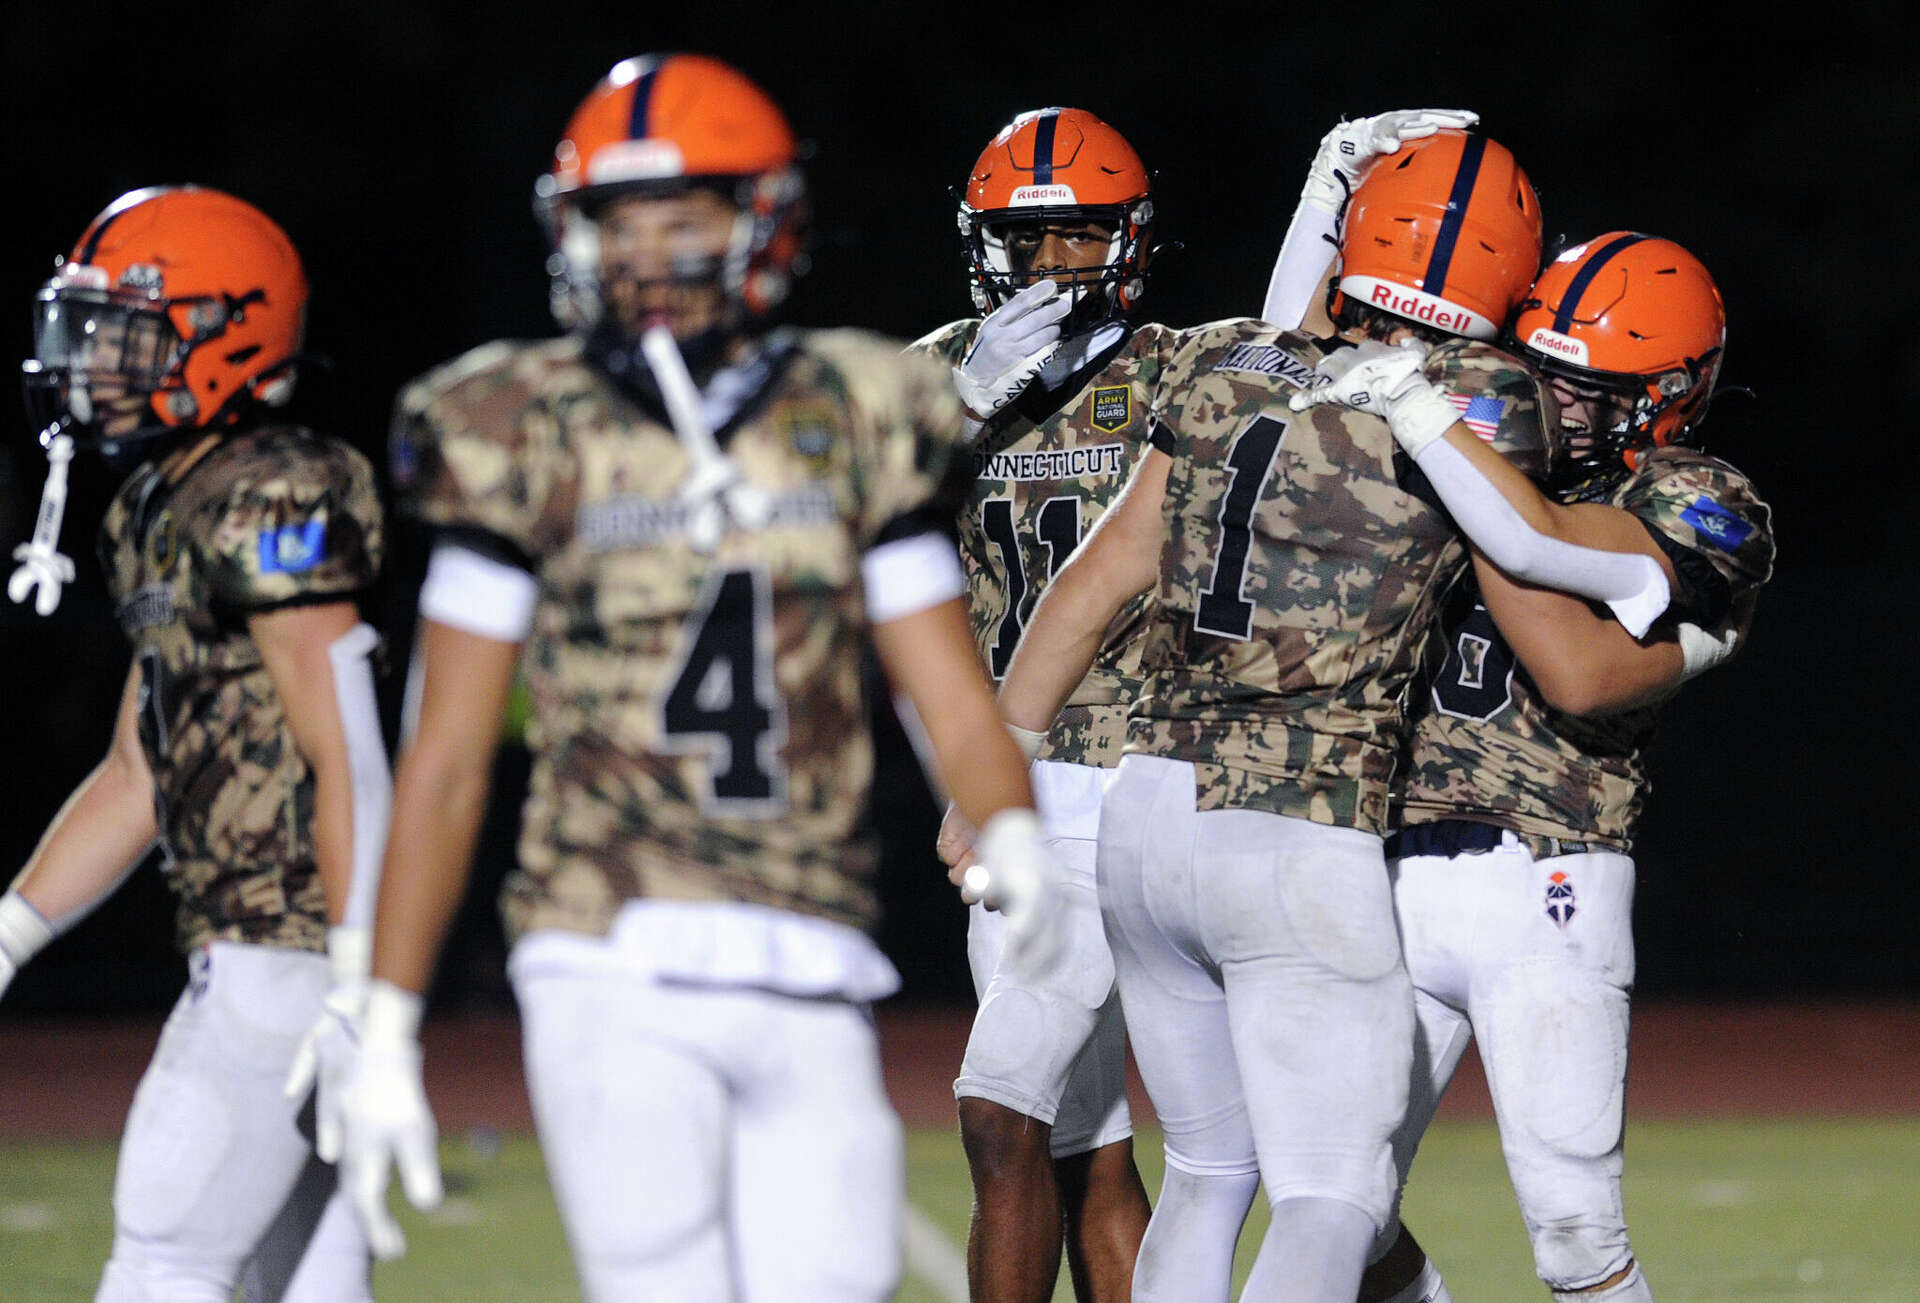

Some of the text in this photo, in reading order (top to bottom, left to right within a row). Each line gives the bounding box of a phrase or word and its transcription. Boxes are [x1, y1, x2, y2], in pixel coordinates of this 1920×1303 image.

[1017, 189, 1067, 200] Riddell
[1371, 284, 1473, 334] Riddell
[1535, 333, 1581, 356] Riddell
[1096, 408, 1126, 419] GUARD
[1097, 395, 1125, 405] ARMY
[972, 446, 1122, 479] ONNECTICUT
[1194, 413, 1288, 641] 1
[660, 565, 780, 810] 4
